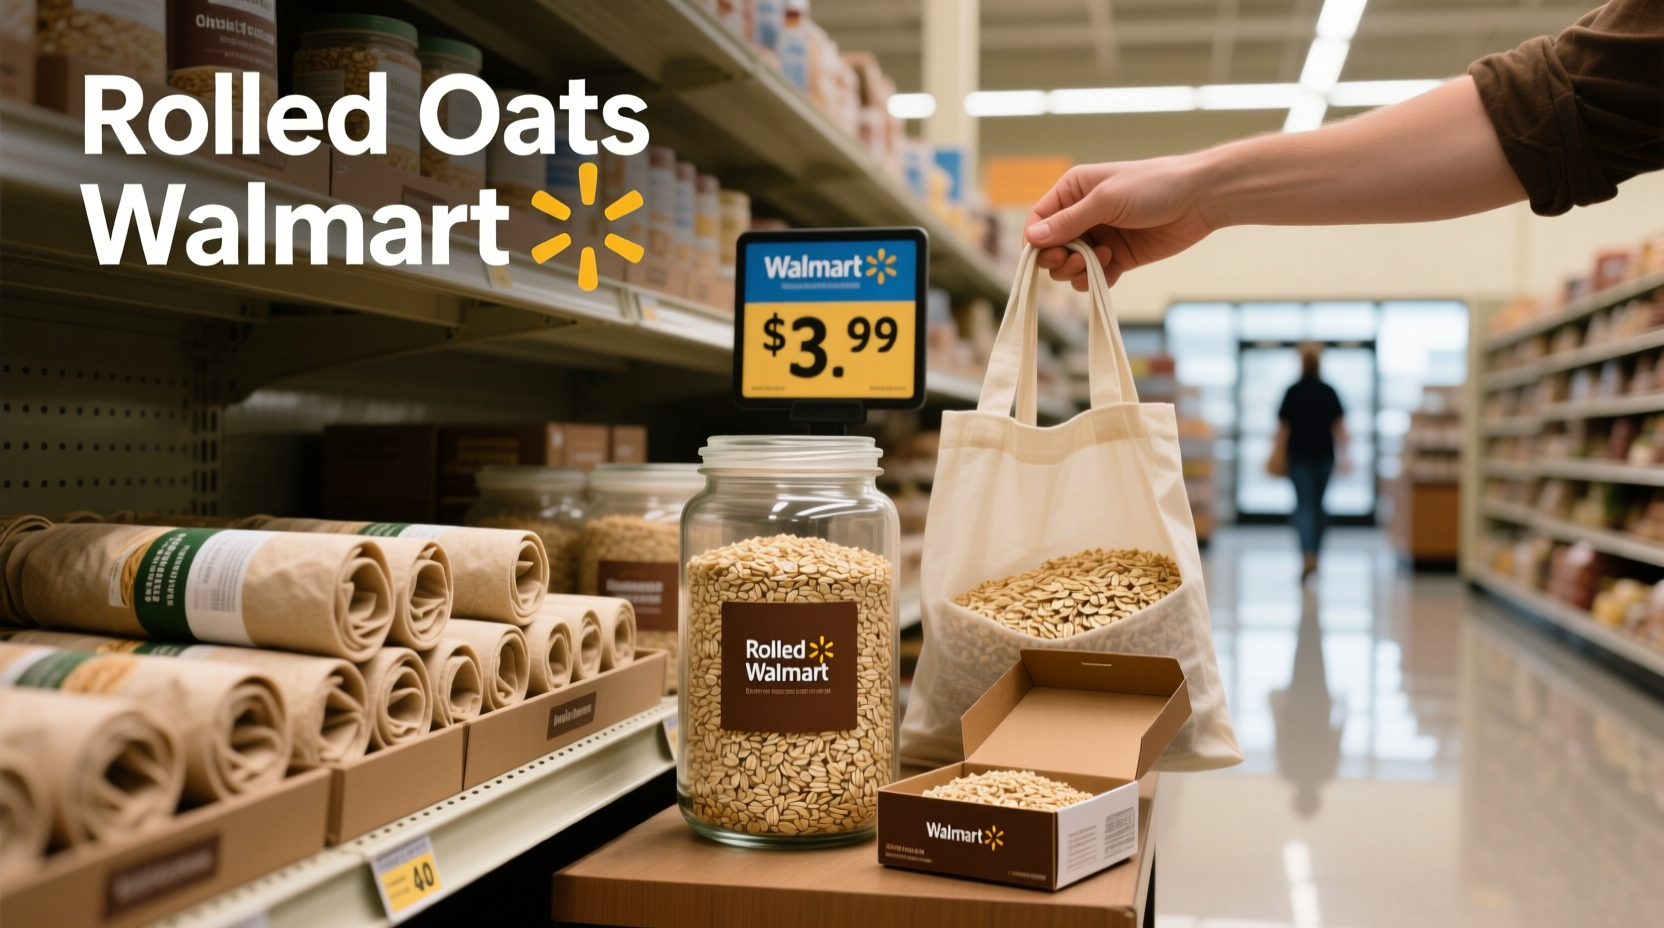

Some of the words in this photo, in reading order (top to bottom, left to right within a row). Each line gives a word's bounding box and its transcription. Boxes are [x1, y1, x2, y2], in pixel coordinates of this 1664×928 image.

[764, 254, 863, 279] Walmart
[746, 639, 806, 660] Rolled
[745, 662, 829, 682] Walmart
[926, 821, 983, 844] Walmart
[413, 862, 435, 892] 40
